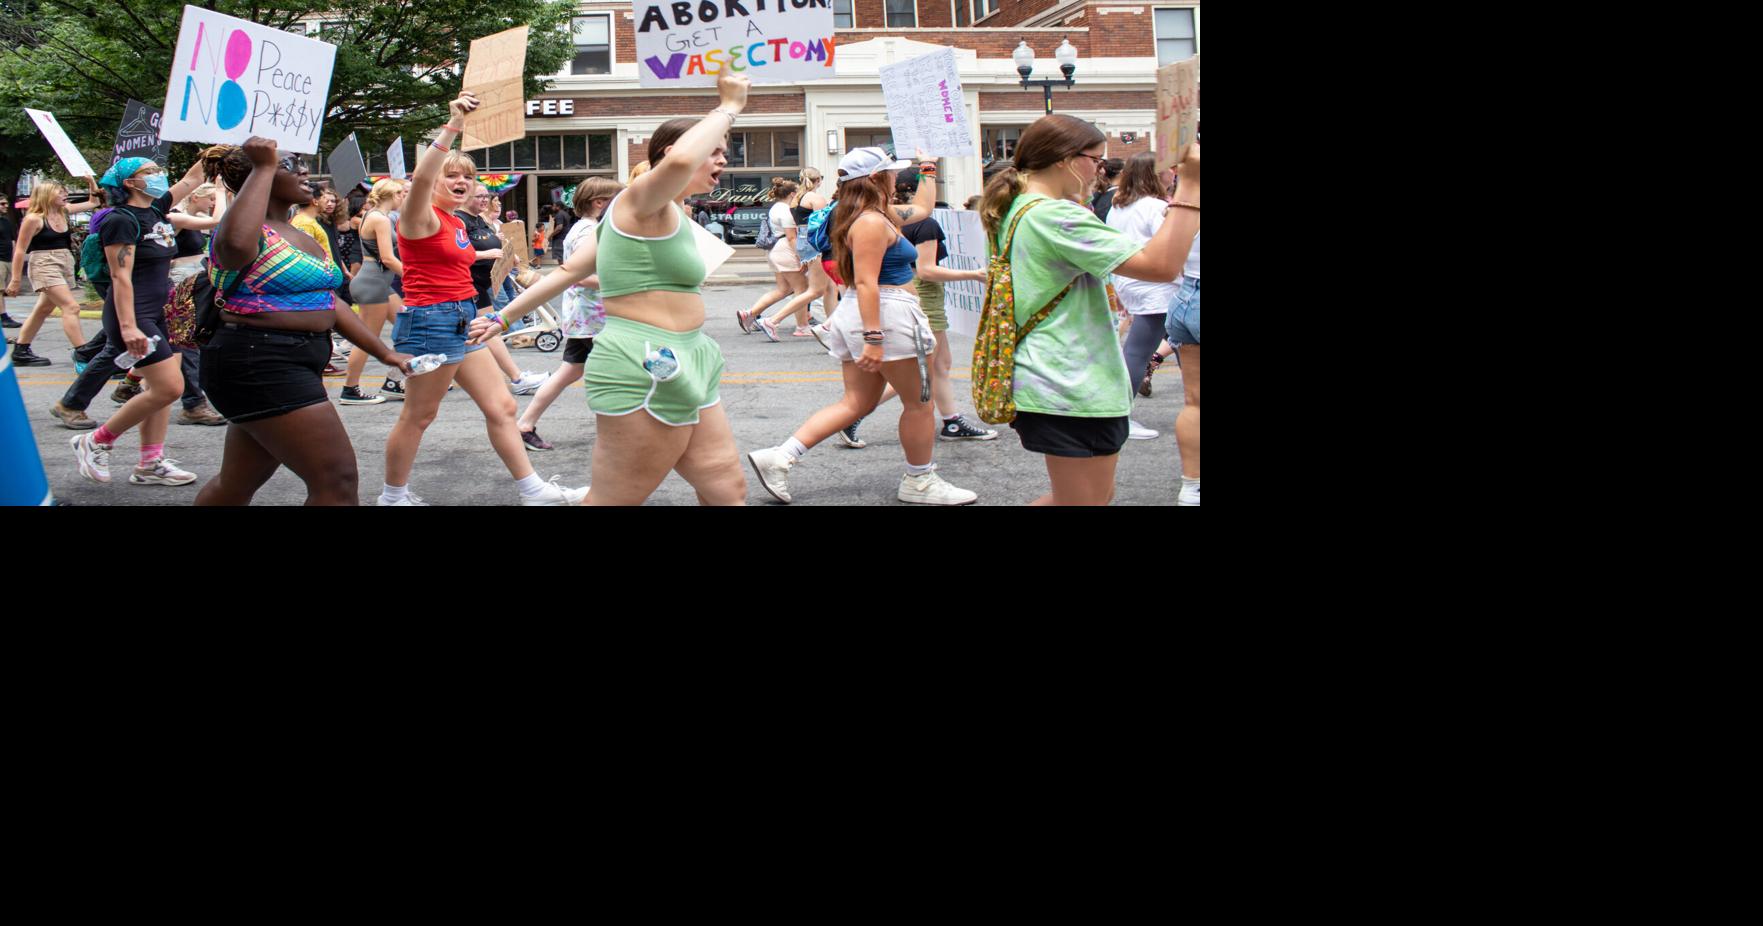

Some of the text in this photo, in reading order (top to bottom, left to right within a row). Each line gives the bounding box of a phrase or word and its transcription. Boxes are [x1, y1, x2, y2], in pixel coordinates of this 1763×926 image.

[644, 35, 836, 80] VASECTOMY
[665, 20, 763, 52] GET A
[190, 22, 312, 95] NO Peace
[180, 75, 248, 130] NO
[937, 79, 954, 123] WOMEN
[736, 184, 758, 192] The
